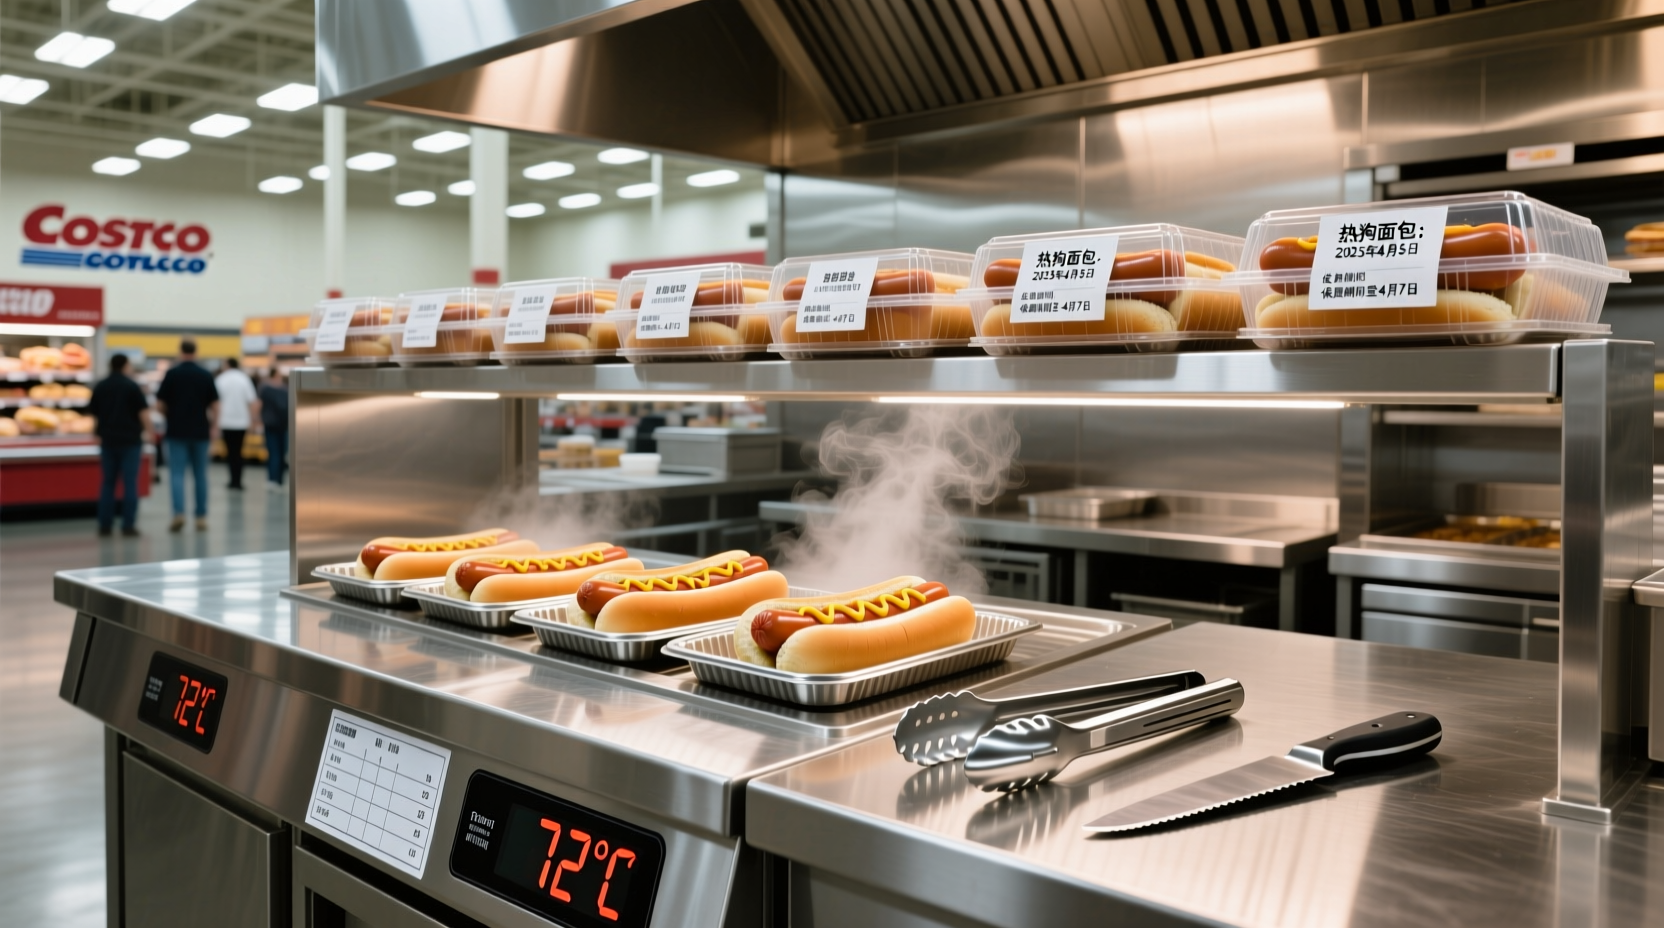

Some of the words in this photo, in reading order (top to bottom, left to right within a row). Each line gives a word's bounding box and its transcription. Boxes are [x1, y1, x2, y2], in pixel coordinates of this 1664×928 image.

[24, 206, 210, 253] COSTCO
[1335, 243, 1418, 258] 2025年4月5日
